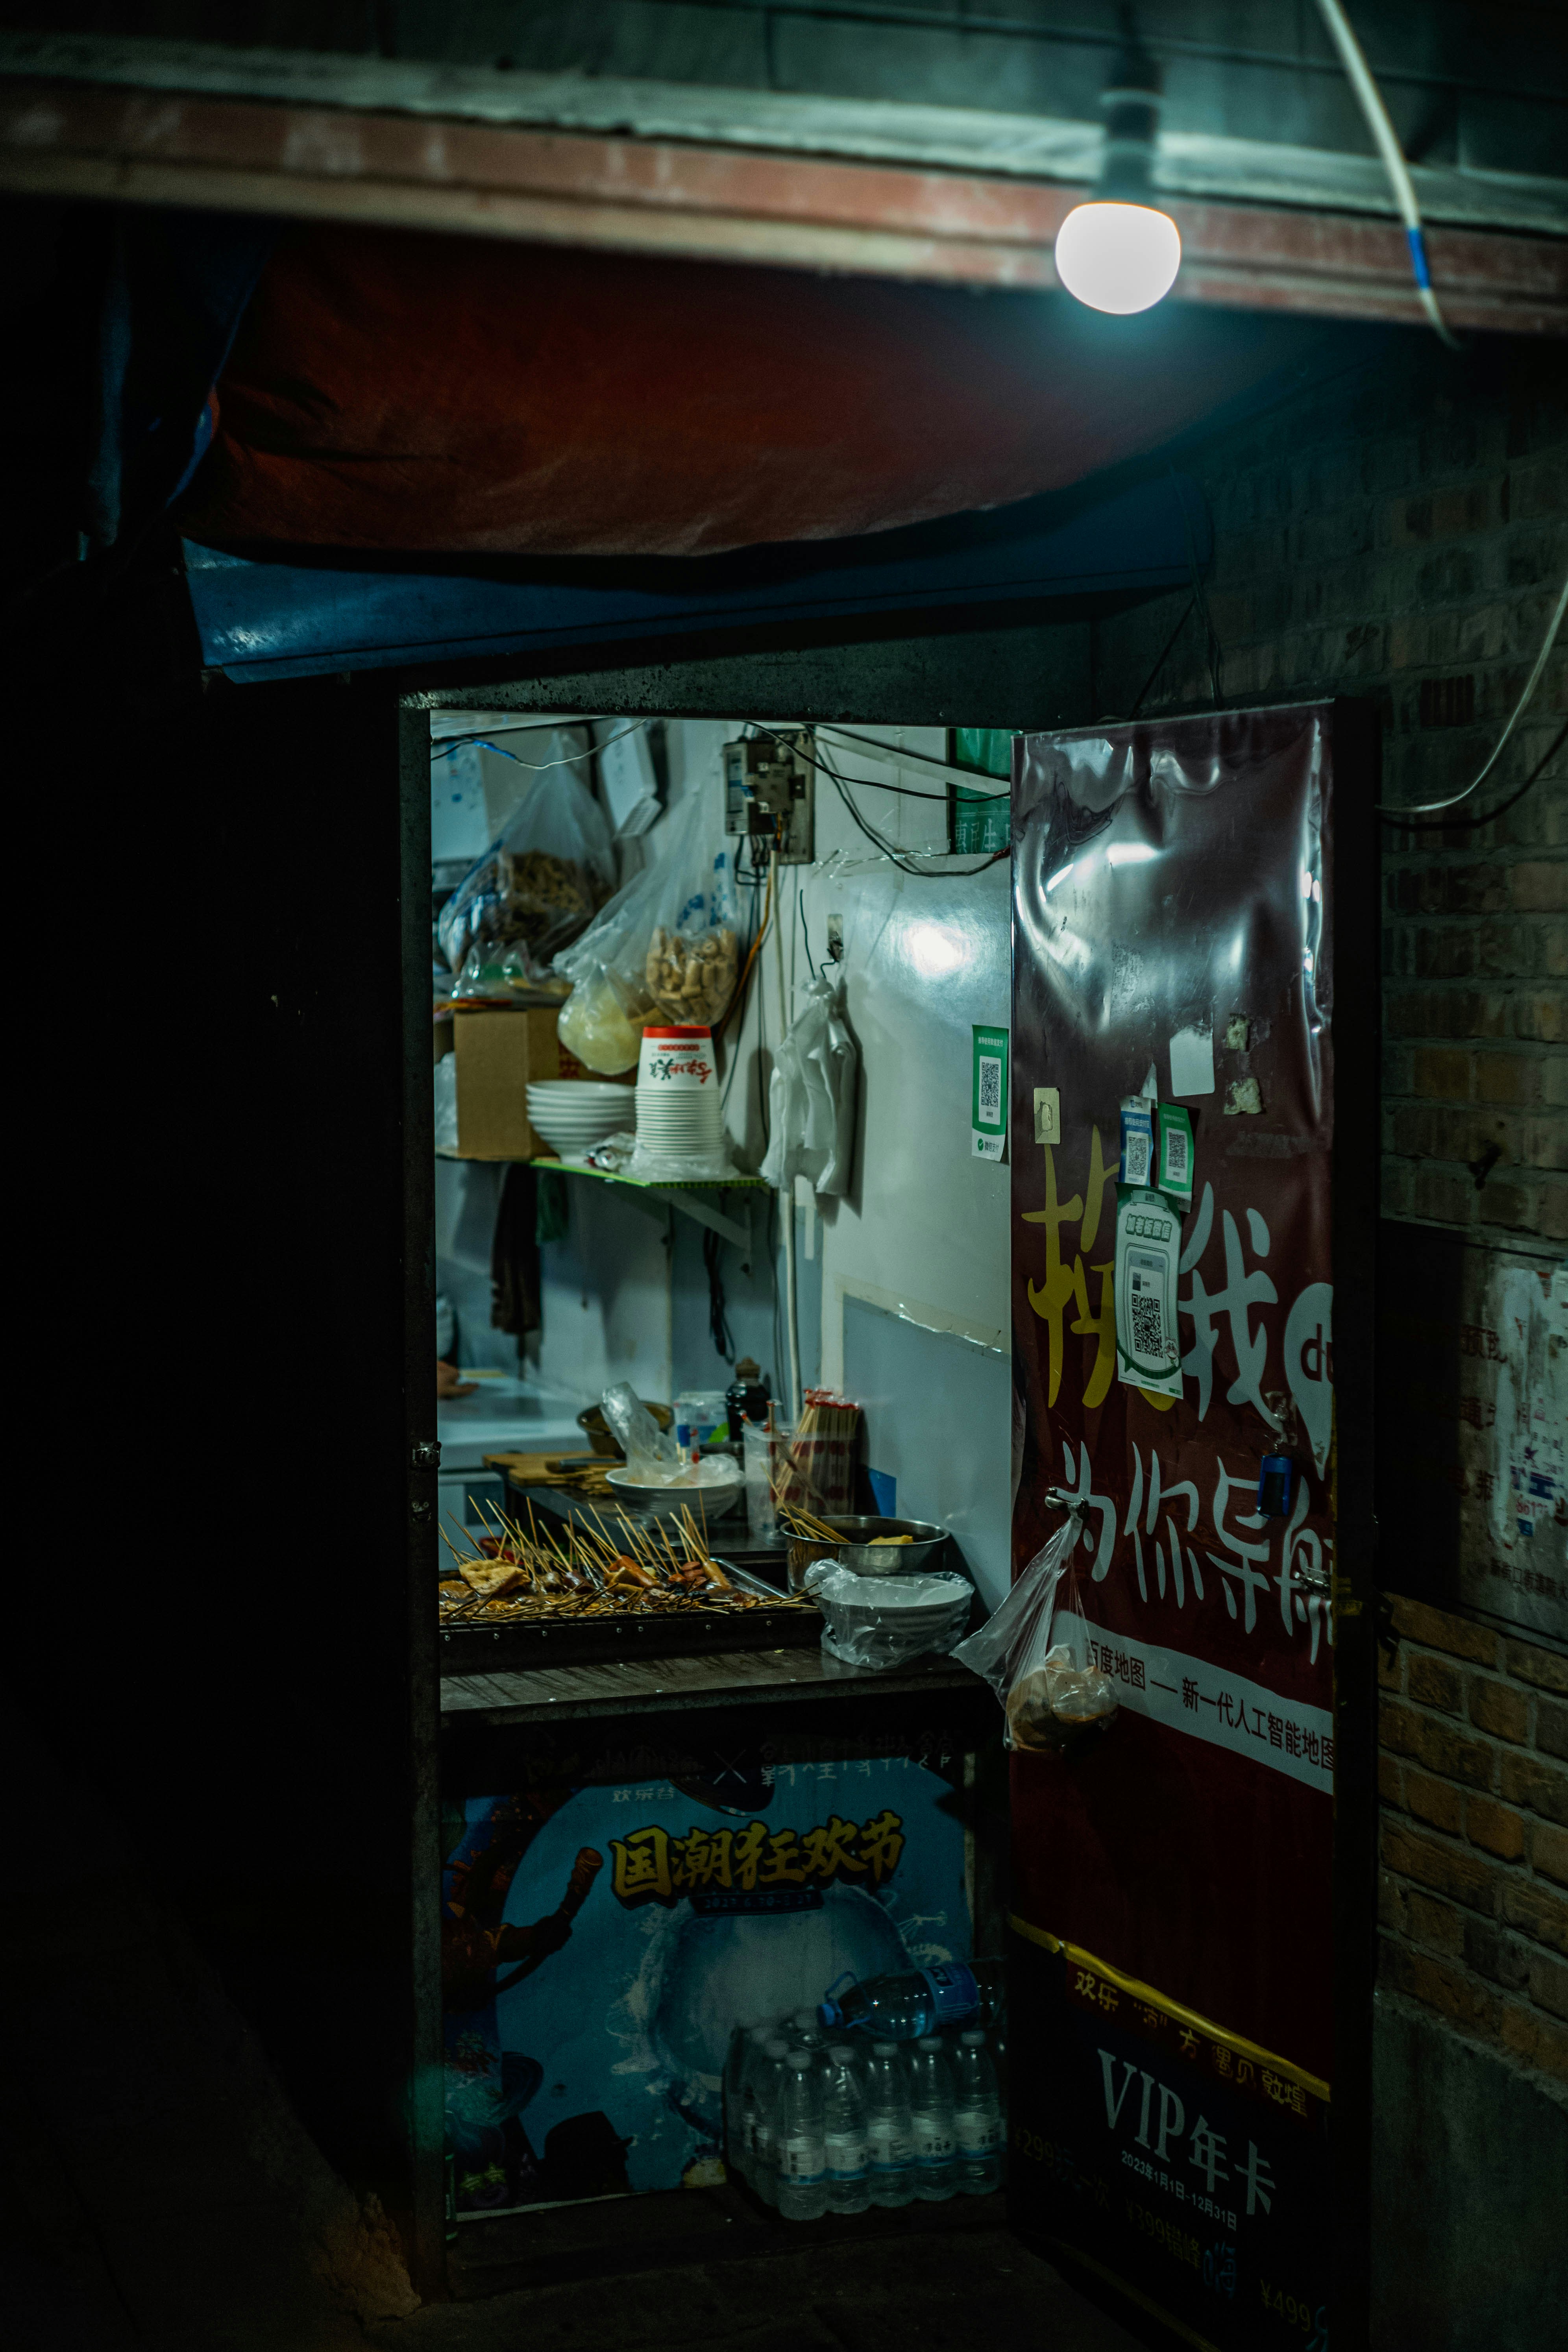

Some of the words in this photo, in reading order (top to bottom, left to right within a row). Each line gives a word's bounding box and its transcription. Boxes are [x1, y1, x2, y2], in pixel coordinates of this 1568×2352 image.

[609, 1810, 904, 1899] 国潮狂欢节
